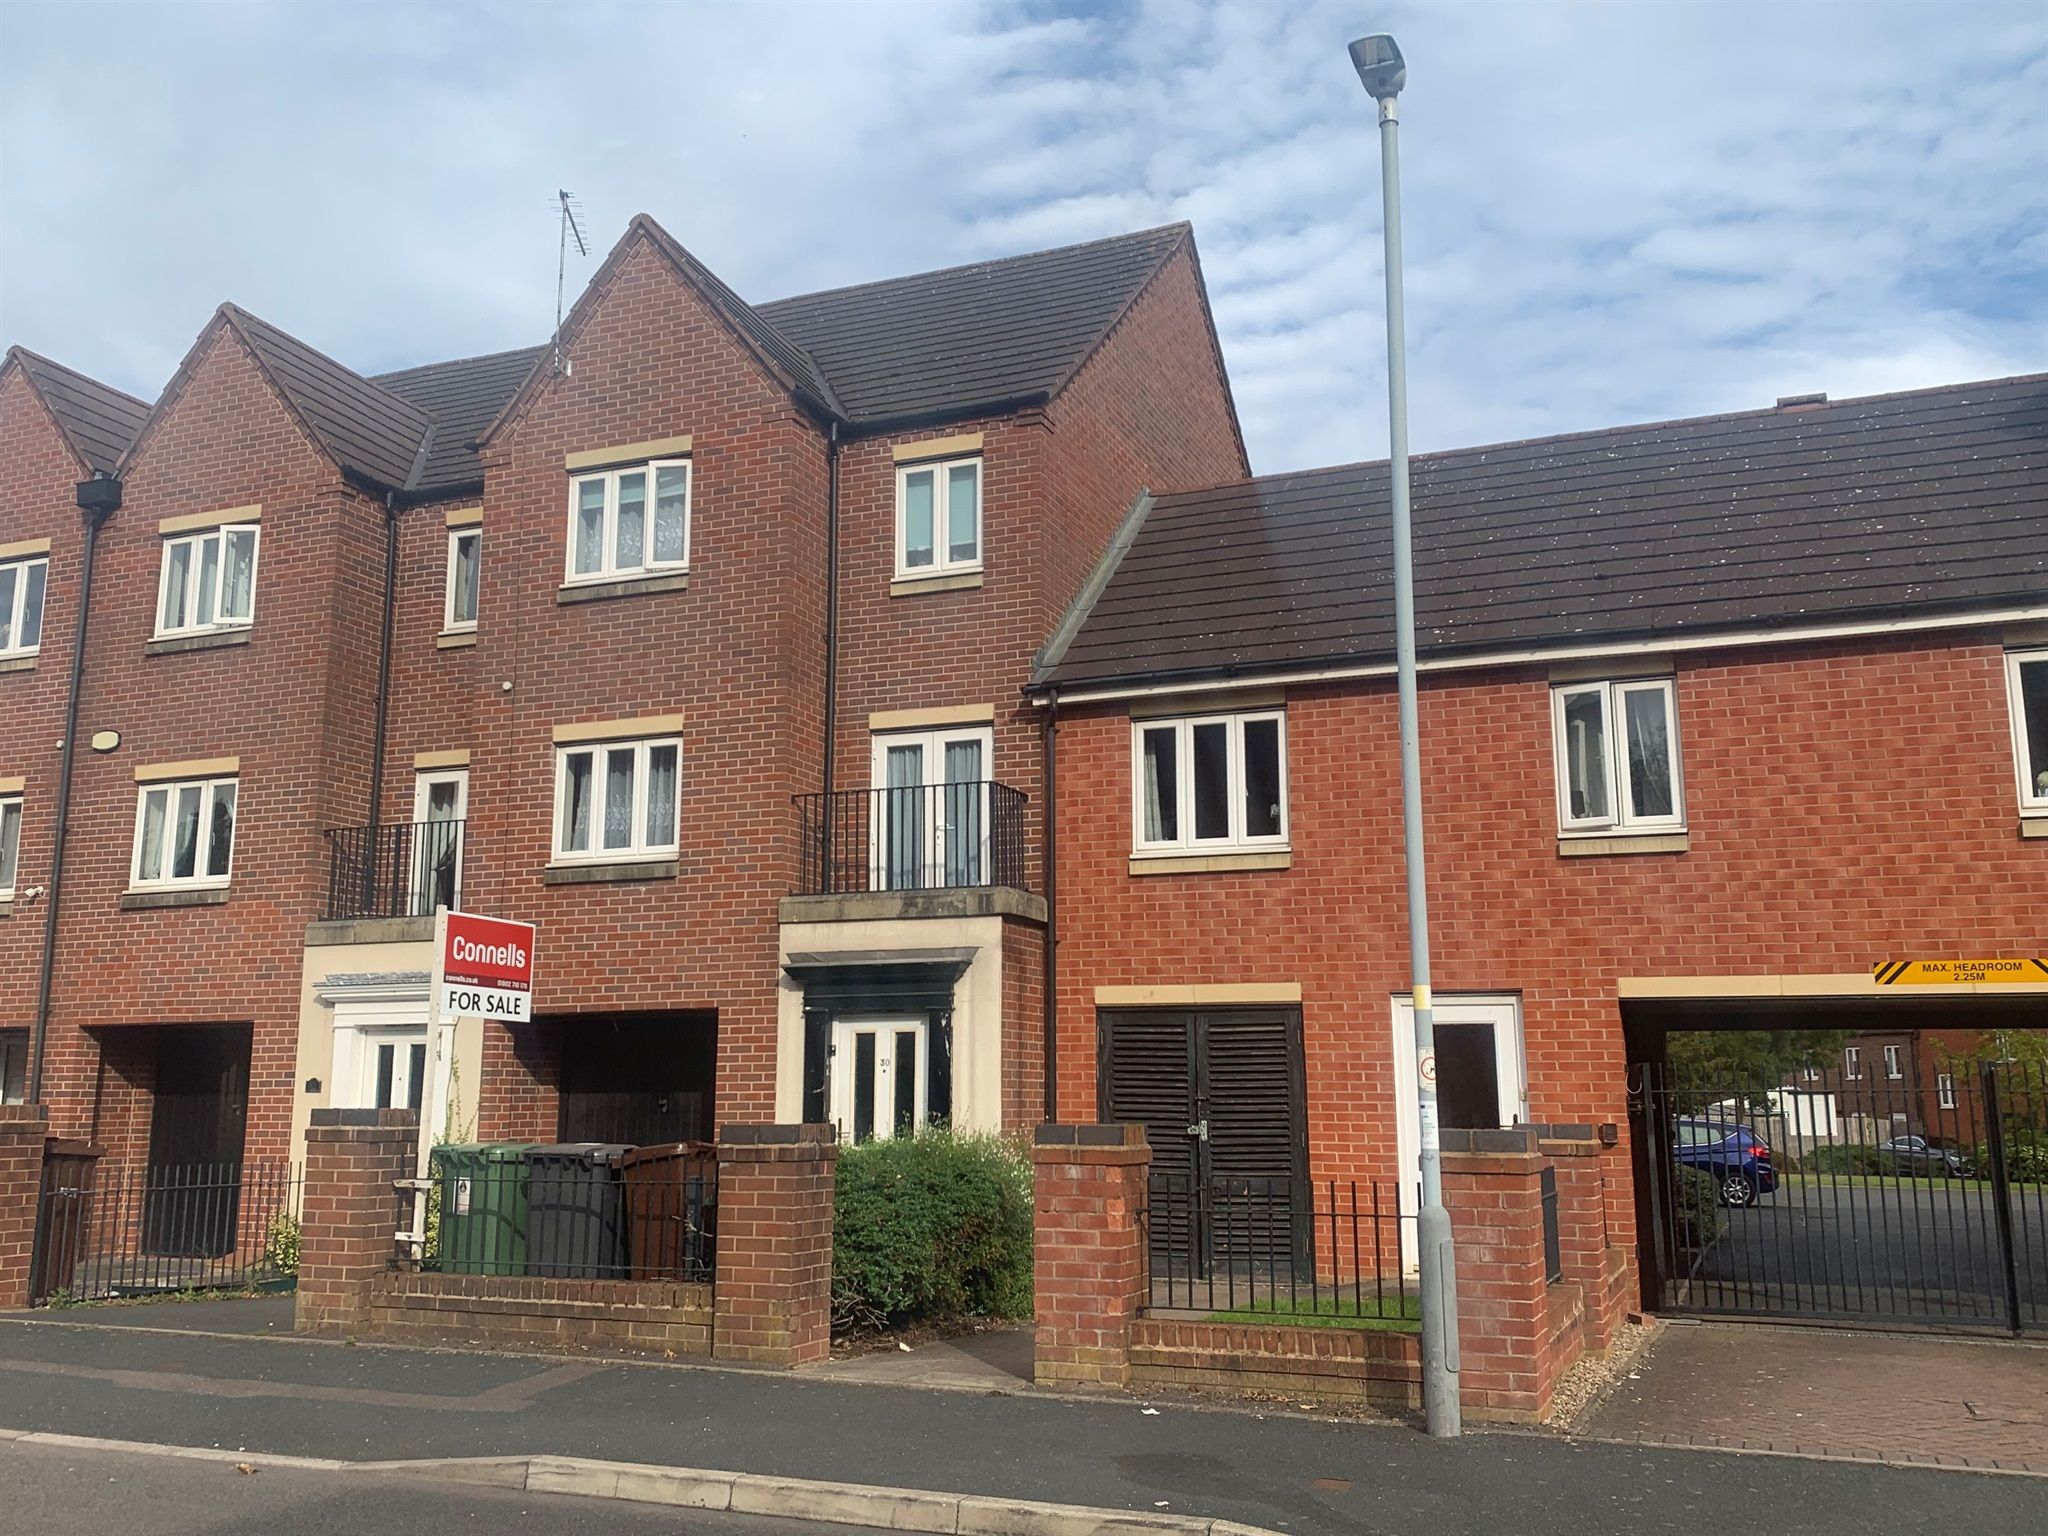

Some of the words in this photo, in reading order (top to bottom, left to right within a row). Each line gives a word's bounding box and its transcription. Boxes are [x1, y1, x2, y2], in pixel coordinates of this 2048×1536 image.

[453, 936, 526, 968] Connells
[1922, 963, 1950, 972] MAX.
[1954, 962, 2023, 972] HEADROOM
[445, 975, 479, 984] connells.co.uk
[1953, 973, 1986, 981] 2.25M
[449, 991, 481, 1011] FOR
[486, 995, 522, 1015] SALE
[880, 1059, 890, 1067] 30
